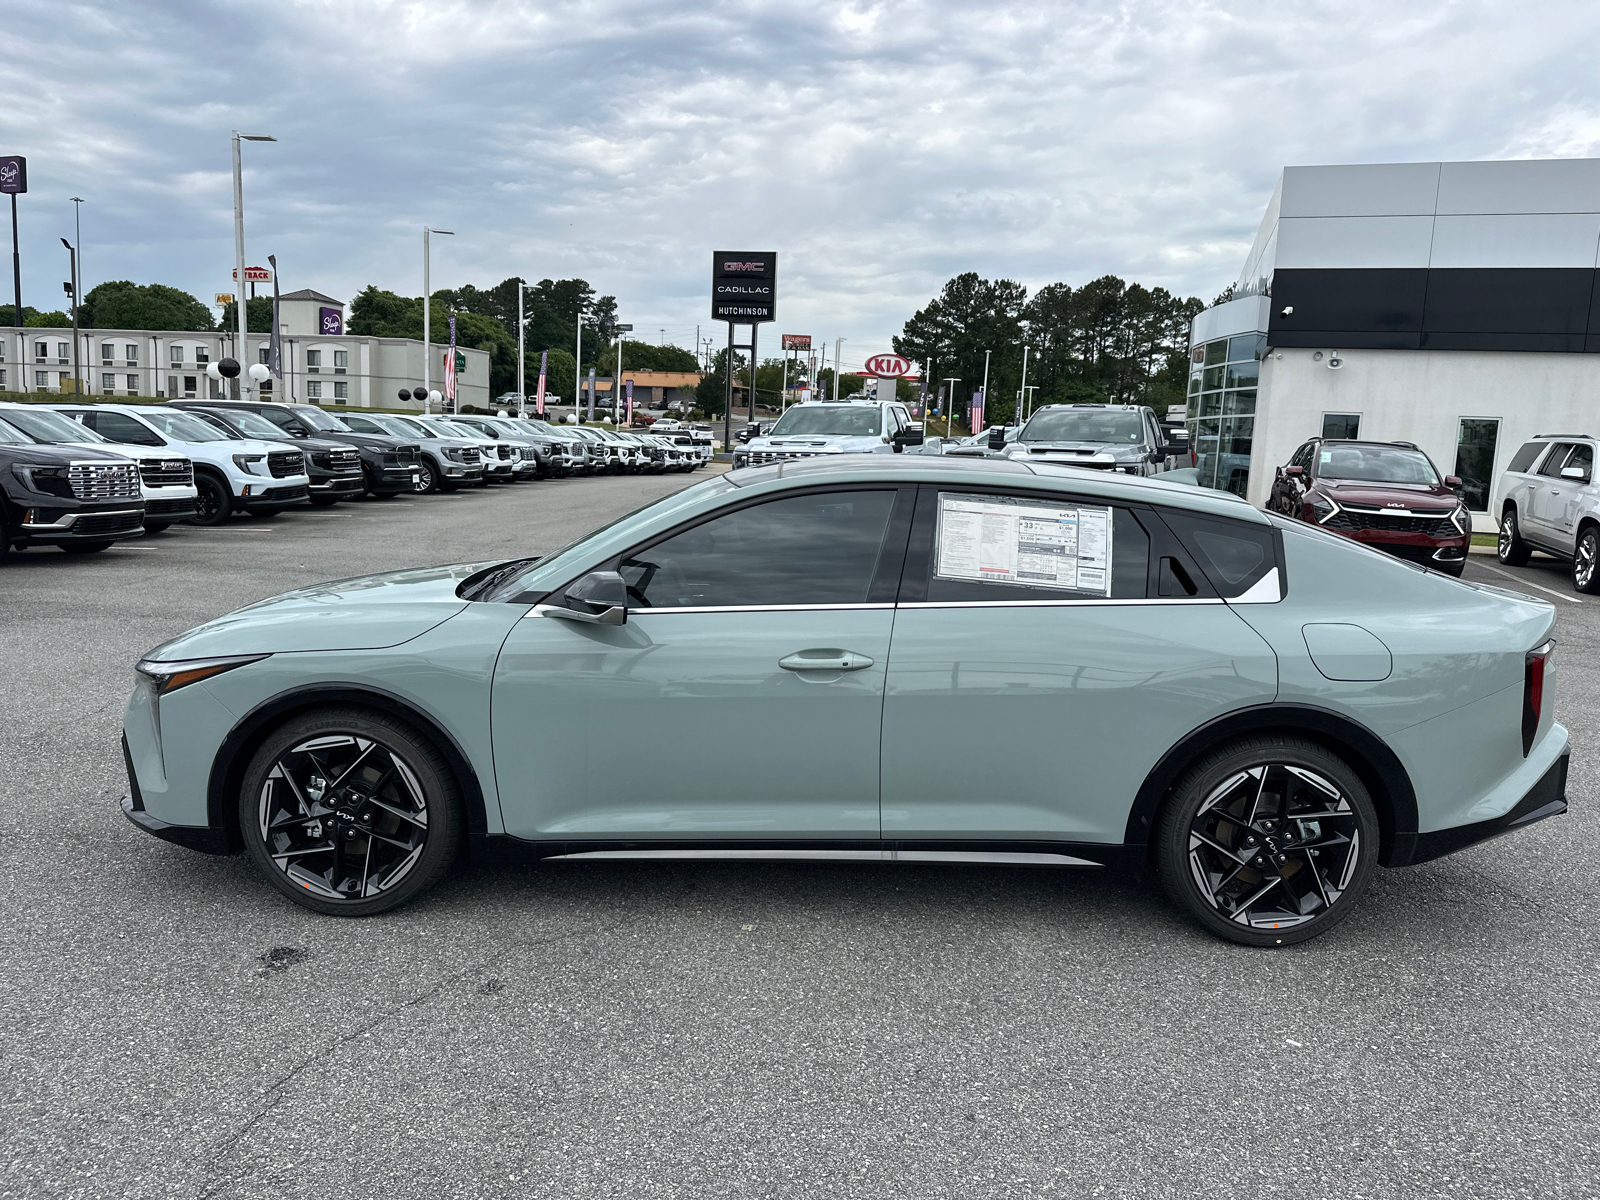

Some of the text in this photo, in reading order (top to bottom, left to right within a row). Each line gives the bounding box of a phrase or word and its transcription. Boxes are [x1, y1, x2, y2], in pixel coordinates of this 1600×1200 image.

[724, 262, 764, 271] GMC
[718, 307, 768, 315] HUTCHINSON
[323, 317, 339, 330] Sleep
[784, 335, 810, 343] Wagers
[874, 359, 903, 373] KIA
[305, 720, 359, 733] KUMHO
